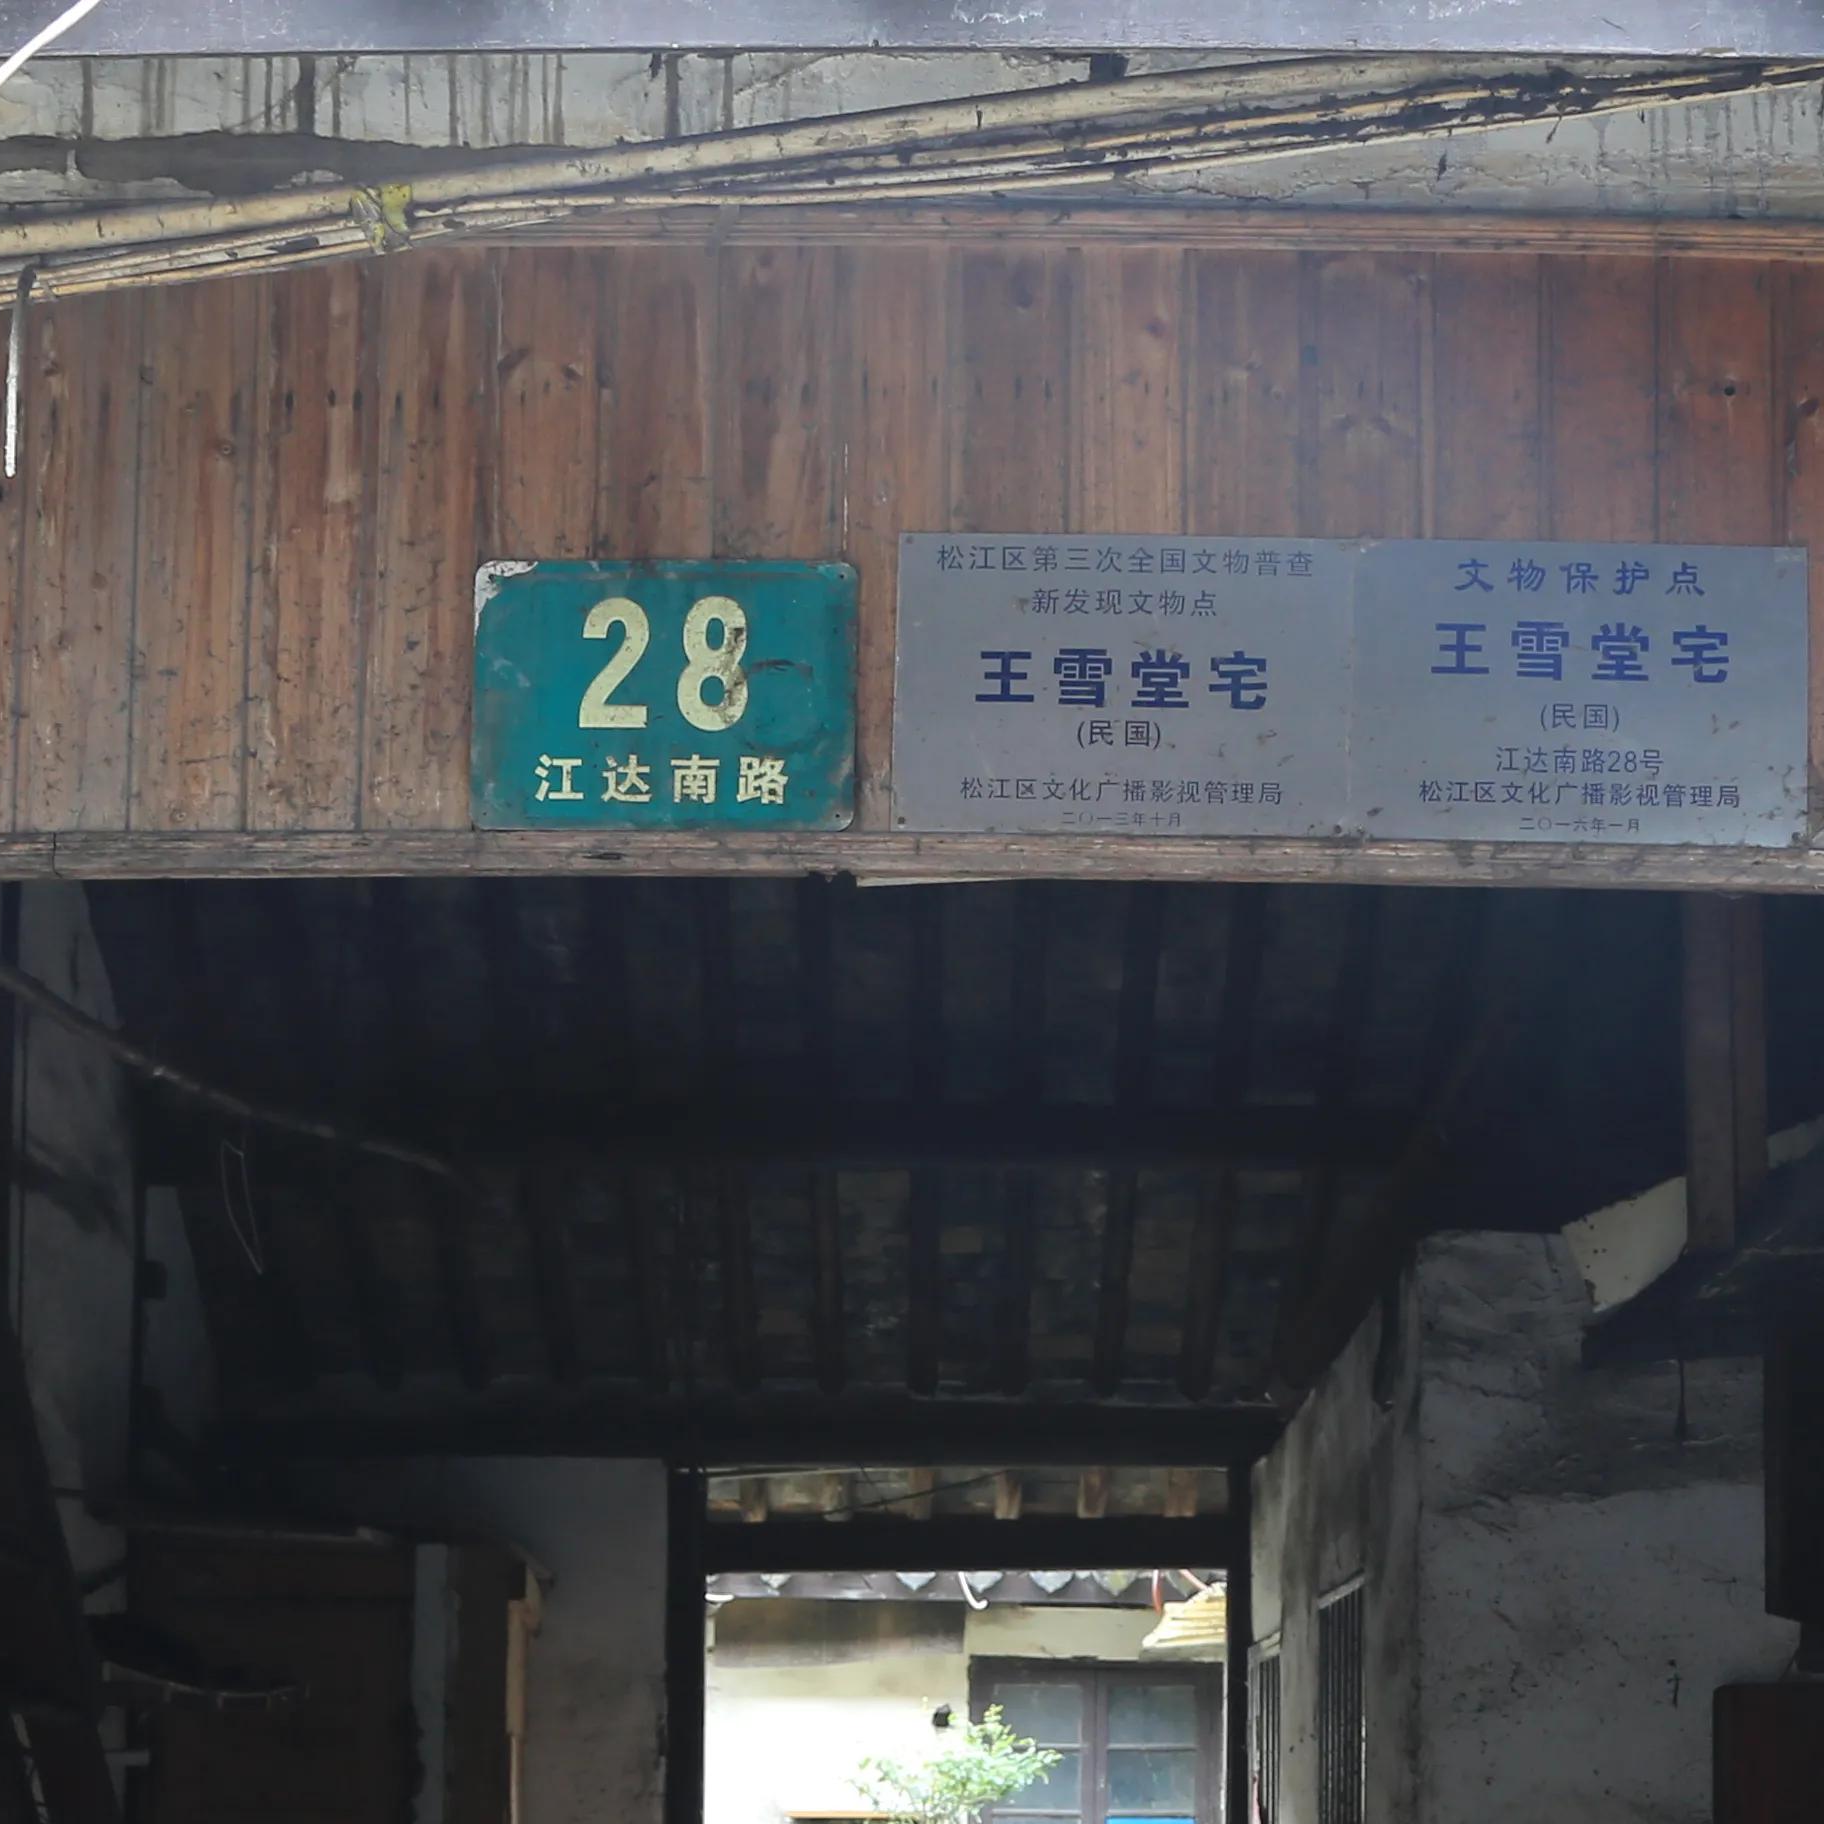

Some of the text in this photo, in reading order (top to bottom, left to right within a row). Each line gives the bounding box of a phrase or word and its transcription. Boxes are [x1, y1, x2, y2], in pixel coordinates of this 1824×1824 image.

[936, 544, 1314, 578] 松江区第三次全国文物普查
[1453, 558, 1706, 597] 文物保护点
[1031, 588, 1218, 617] 新发现文物点
[579, 596, 748, 731] 28
[1431, 621, 1729, 684] 王雪堂宅
[975, 648, 1268, 710] 王雪堂宅
[1540, 703, 1621, 733] (民国)
[1077, 720, 1161, 749] (民国)
[1495, 747, 1664, 775] 江达南路28号
[534, 754, 789, 805] 江达南路
[960, 777, 1283, 805] 松江区文化广播影视管理局
[1419, 780, 1741, 809] 松江区文化广播影视管理局
